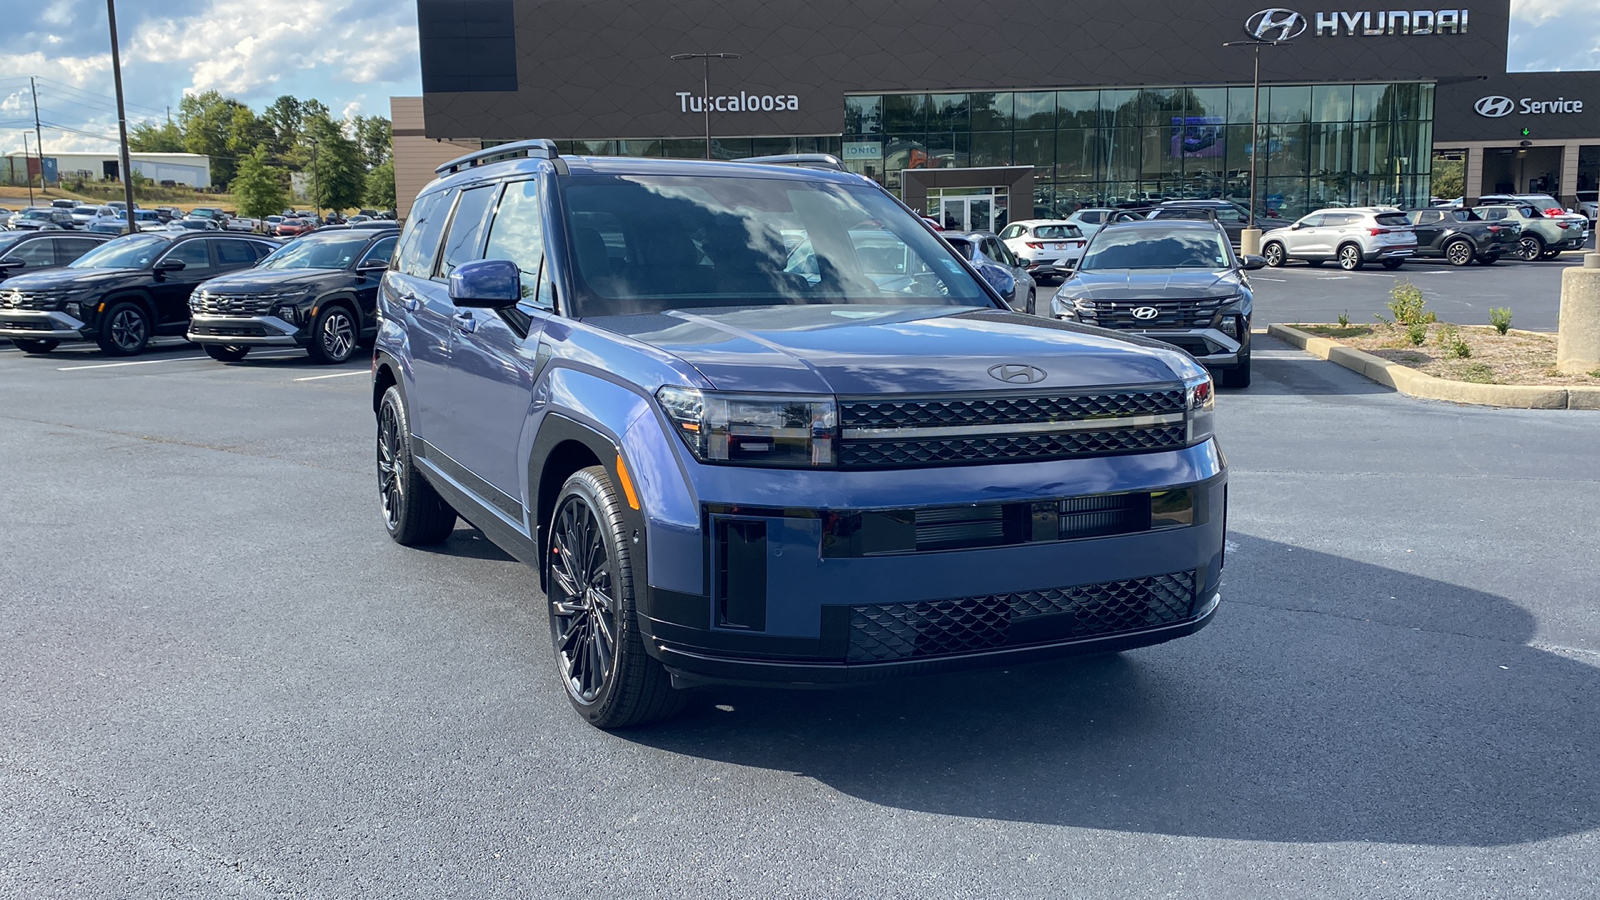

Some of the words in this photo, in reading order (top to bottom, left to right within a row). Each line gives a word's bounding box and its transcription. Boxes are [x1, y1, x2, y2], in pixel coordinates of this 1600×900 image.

[1315, 9, 1469, 37] HYUNDAI
[675, 90, 799, 113] Tuscaloosa
[1519, 96, 1583, 114] Service
